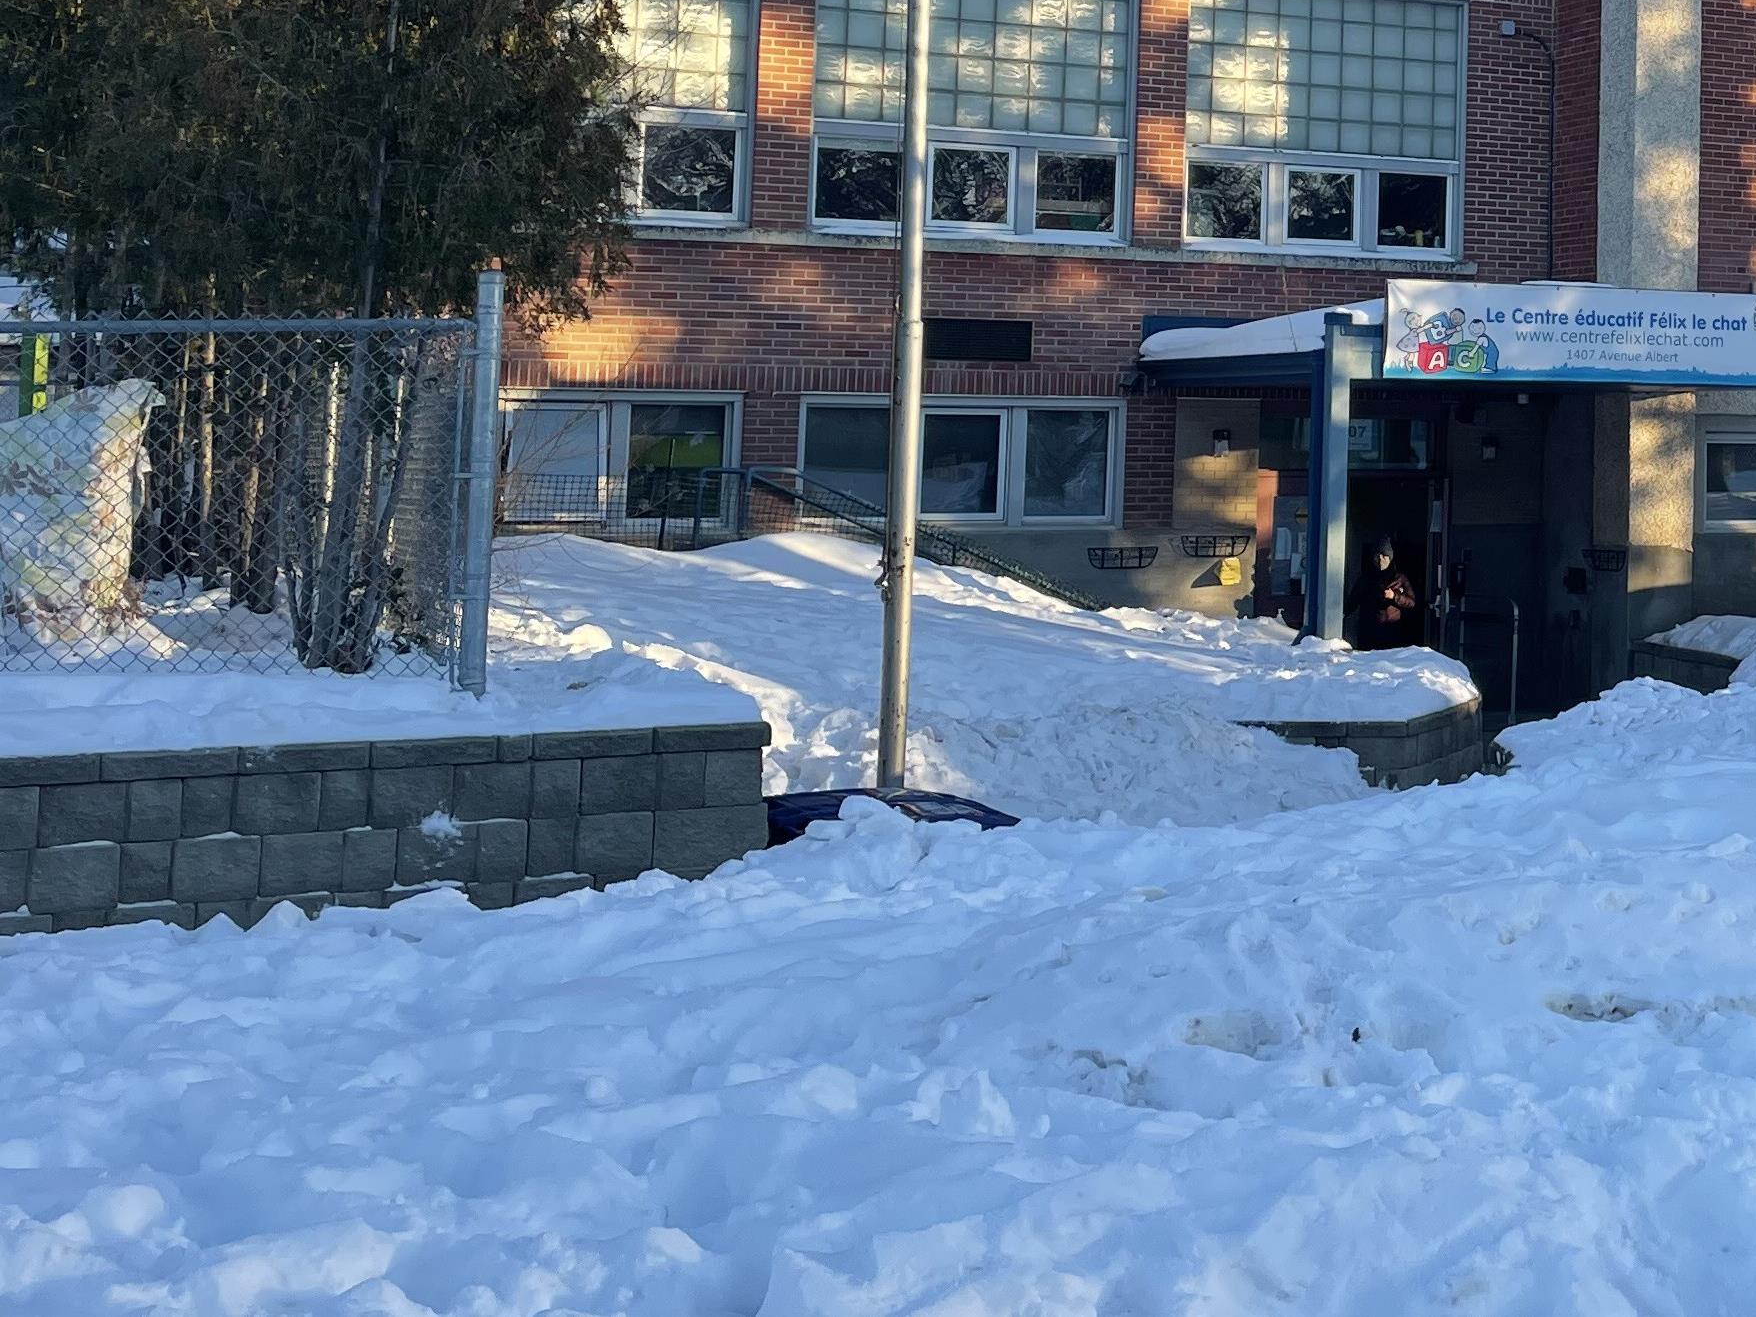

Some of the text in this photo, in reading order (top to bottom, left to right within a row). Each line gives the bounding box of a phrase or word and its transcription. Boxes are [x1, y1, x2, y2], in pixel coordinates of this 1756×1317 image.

[1486, 307, 1505, 323] Le
[1512, 308, 1568, 326] Centre
[1575, 309, 1644, 328] éducatif
[1650, 311, 1687, 329] Félix
[1692, 314, 1707, 329] le
[1712, 315, 1748, 331] chat
[1515, 329, 1724, 348] www.centrefelixlechat.com
[1428, 351, 1446, 369] A
[1567, 349, 1679, 363] 1407 Avenue Albert
